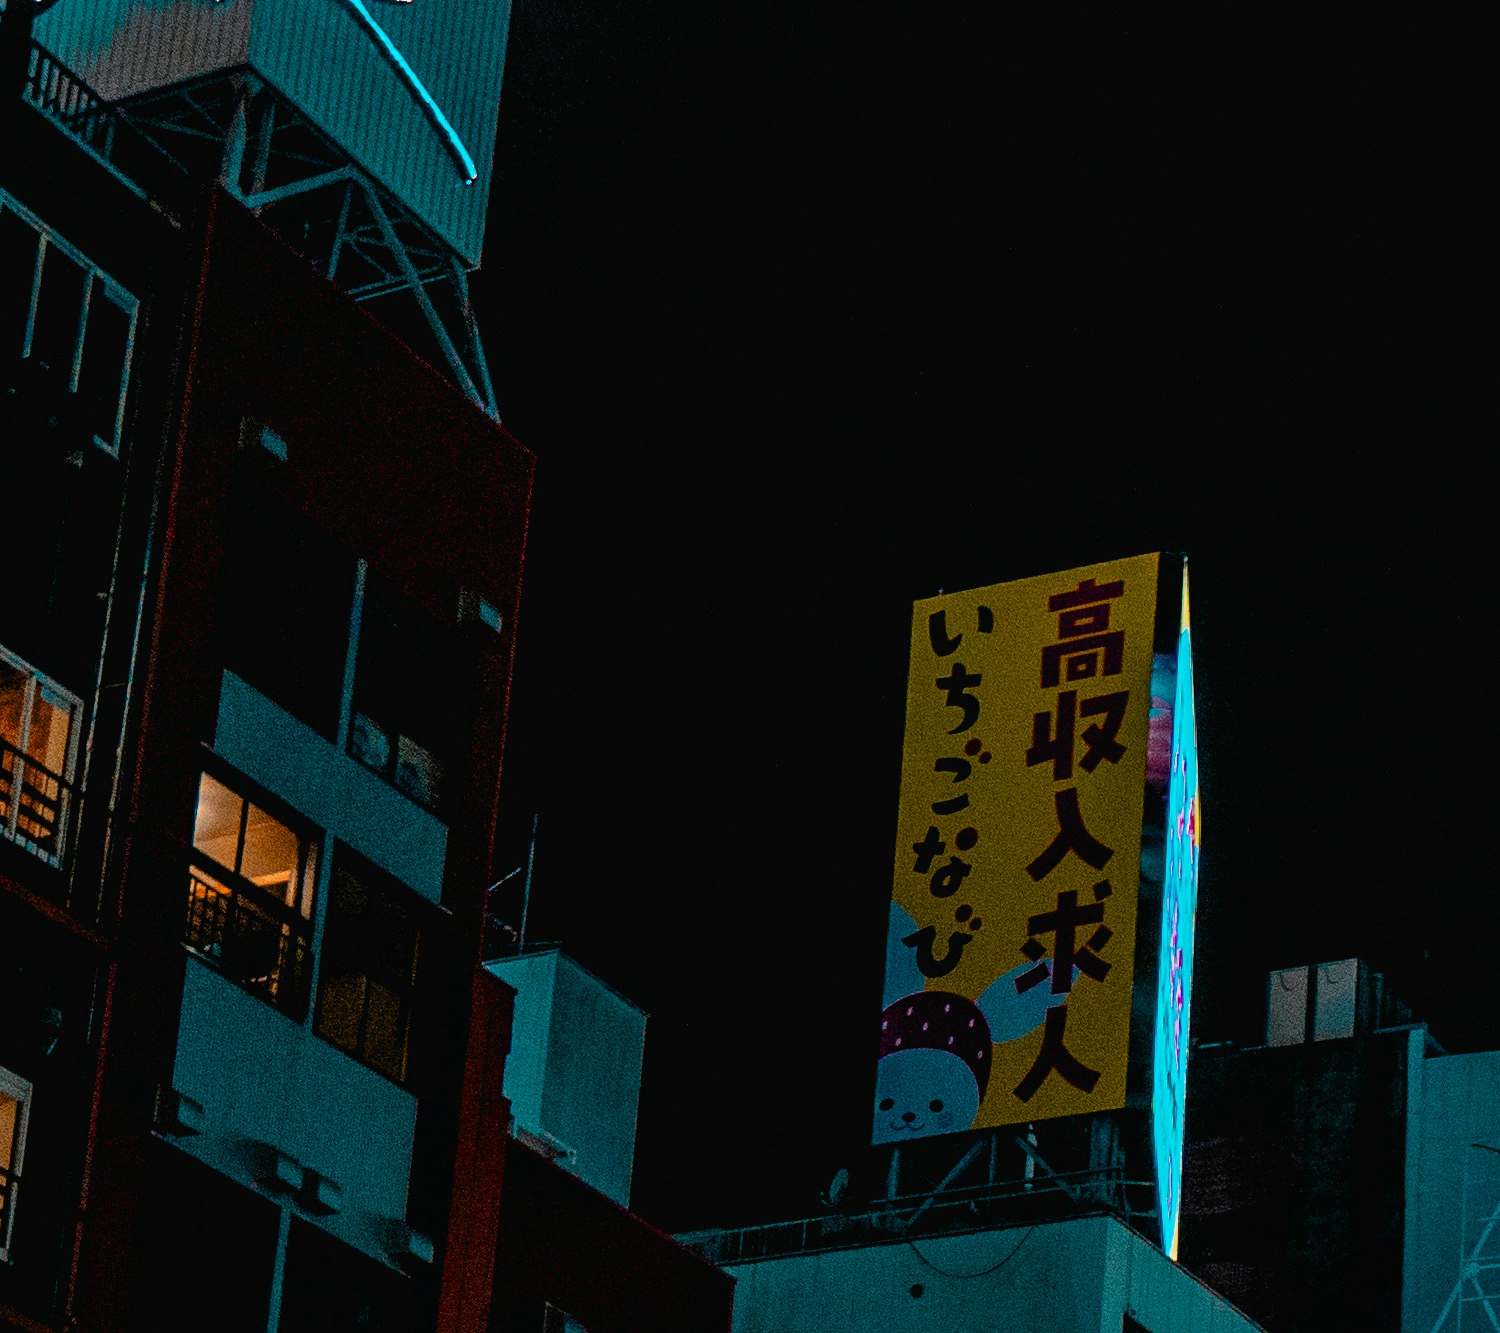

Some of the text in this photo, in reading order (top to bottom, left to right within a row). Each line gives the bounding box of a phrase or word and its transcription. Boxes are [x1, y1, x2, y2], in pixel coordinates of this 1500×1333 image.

[902, 604, 994, 980] いちごなび
[1012, 578, 1129, 1104] 高収入求人
